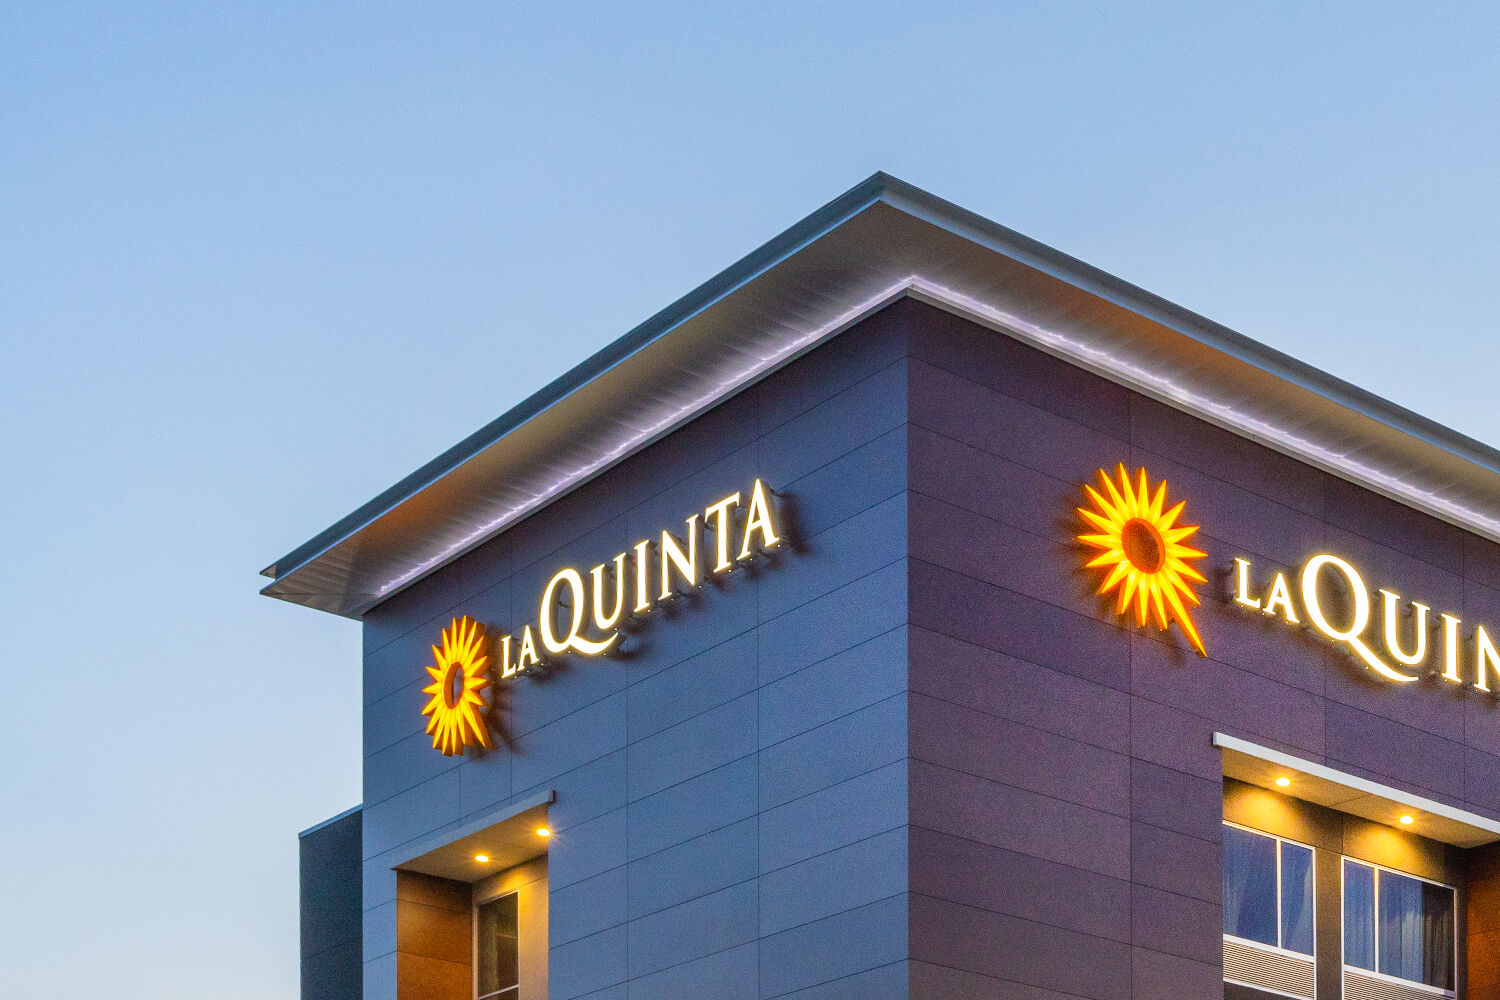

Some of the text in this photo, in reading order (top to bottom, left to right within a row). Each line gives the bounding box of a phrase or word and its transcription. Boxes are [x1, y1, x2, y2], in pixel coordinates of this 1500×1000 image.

[501, 478, 780, 679] LA QUINTA
[1234, 557, 1300, 624] LA
